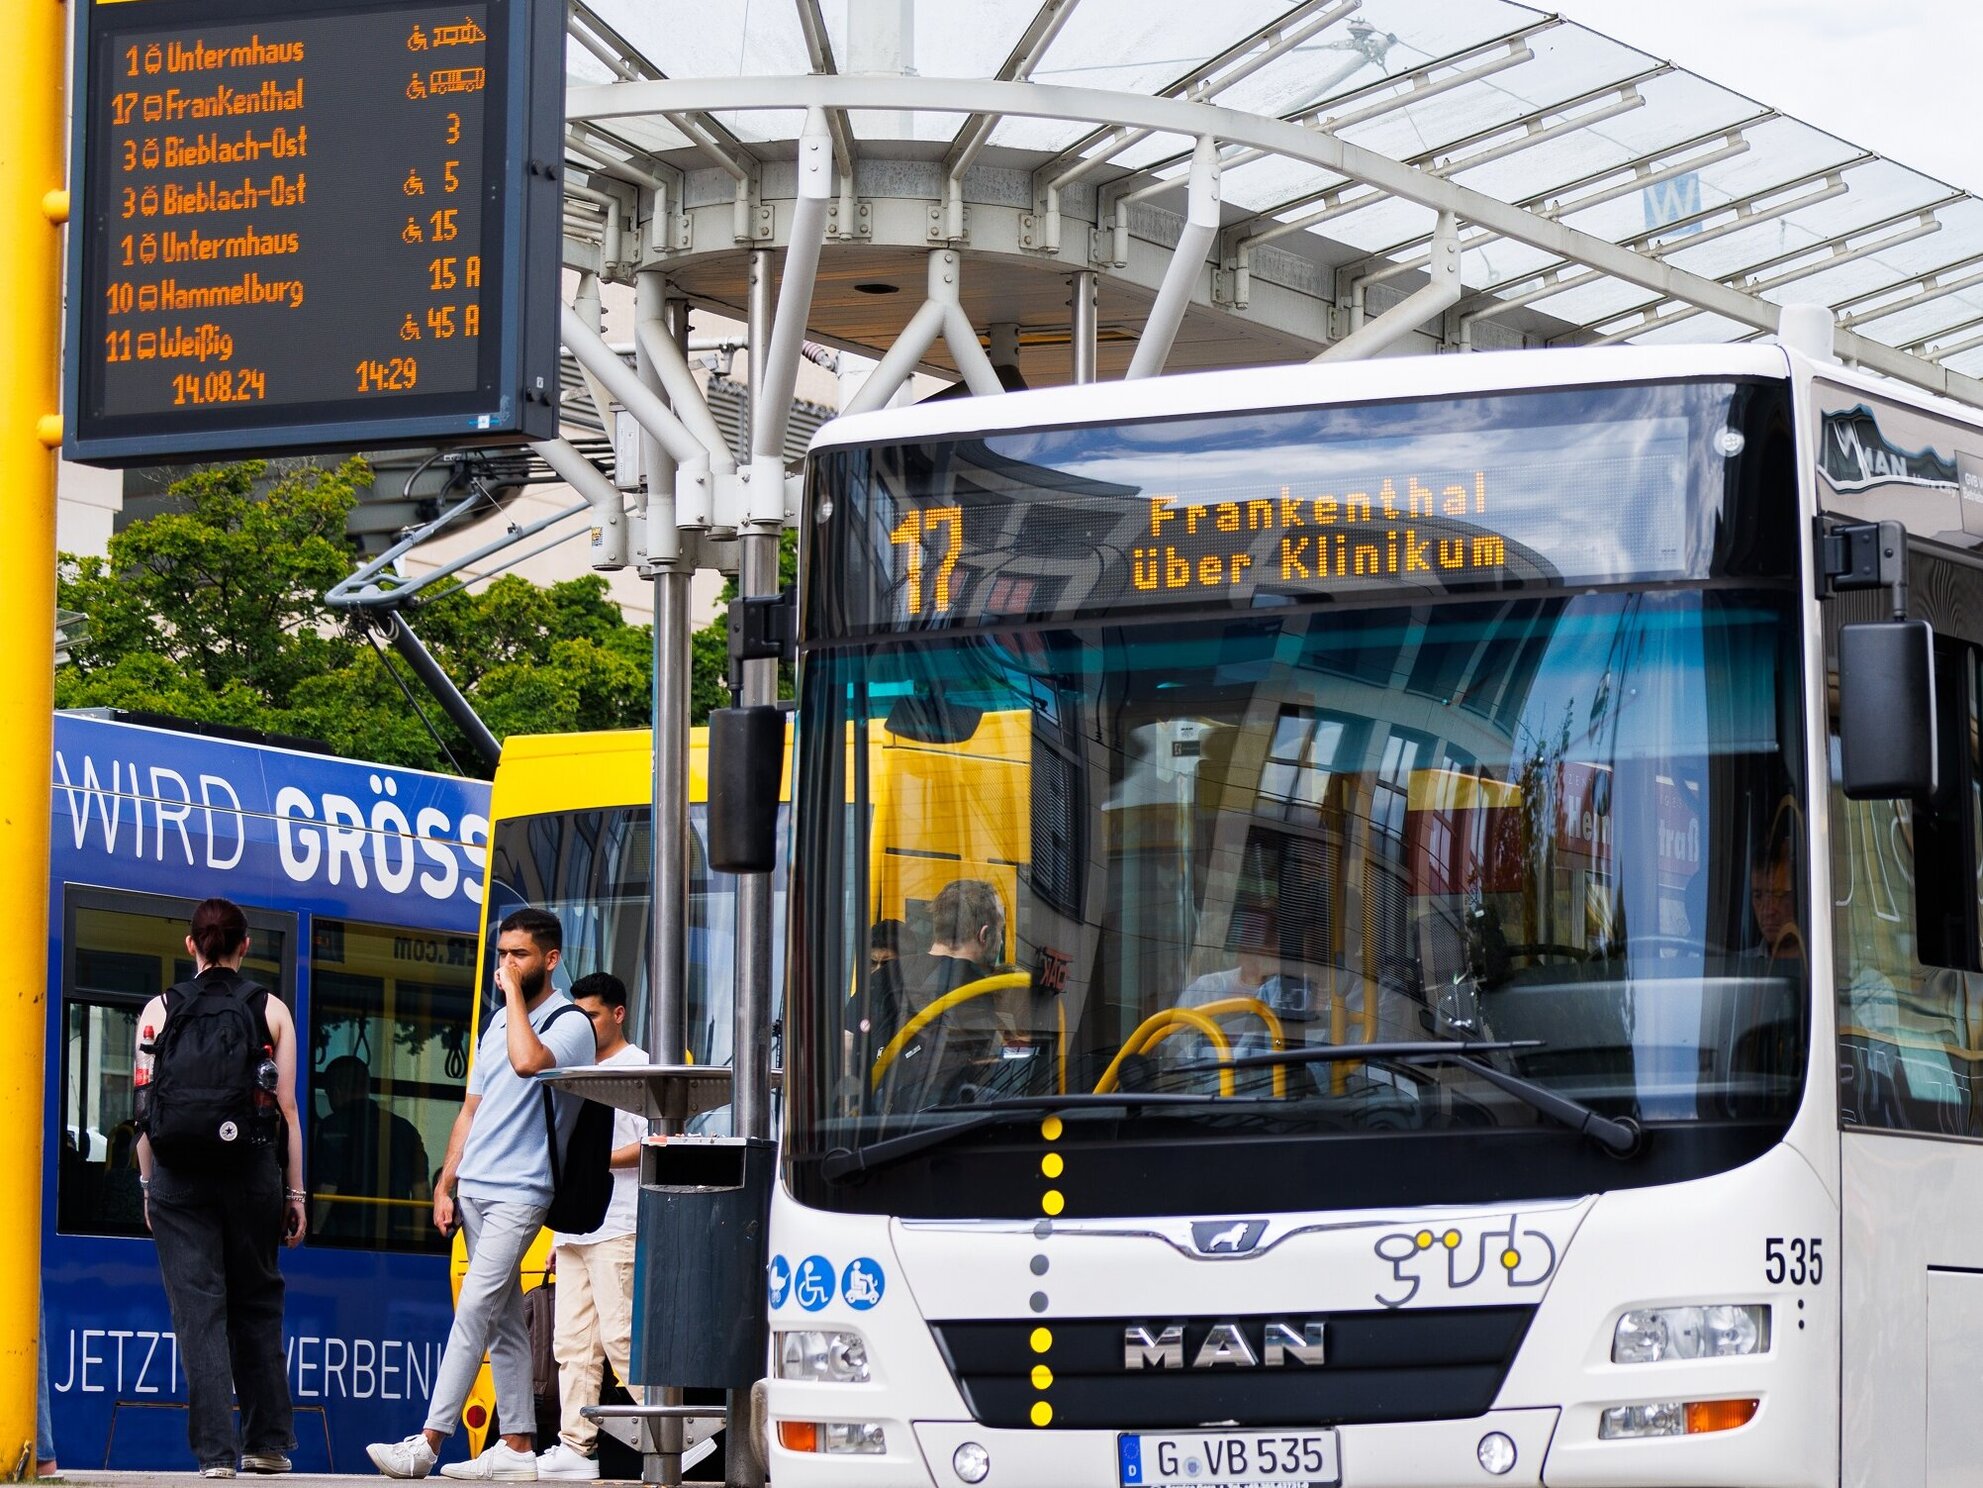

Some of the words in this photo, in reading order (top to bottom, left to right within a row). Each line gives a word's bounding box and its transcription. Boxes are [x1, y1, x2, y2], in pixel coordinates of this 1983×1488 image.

[126, 45, 139, 77] 1
[167, 34, 305, 73] Untermhaus
[112, 92, 139, 125] 17
[166, 78, 304, 121] Frankenthal
[123, 139, 137, 172] 3
[164, 125, 308, 168] Bieblach-Ost
[446, 112, 461, 145] 3
[122, 187, 136, 219] 3
[163, 173, 307, 216] Bieblach-Ost
[444, 160, 459, 193] 5
[121, 234, 134, 266] 1
[162, 225, 299, 263] Untermhaus
[430, 209, 458, 242] 15
[106, 282, 134, 315] 10
[161, 272, 304, 310] Hammelburg
[429, 257, 457, 291] 15
[465, 256, 481, 288] A
[106, 329, 132, 363] 11
[160, 322, 234, 363] Weißig
[427, 306, 456, 339] 45
[464, 304, 480, 337] A
[173, 368, 265, 405] 14.08.24
[355, 357, 417, 392] 14:29
[1151, 470, 1486, 538] Frankenthal
[890, 505, 963, 614] 17
[1133, 547, 1252, 590] über
[1281, 528, 1505, 580] Klinikum
[55, 750, 246, 871] WIRD
[1765, 1237, 1824, 1286] 535
[55, 1329, 177, 1394] JETZT
[1124, 1321, 1328, 1370] MAN
[1158, 1441, 1179, 1476] G
[1203, 1439, 1248, 1476] VB
[1256, 1437, 1323, 1474] 535
